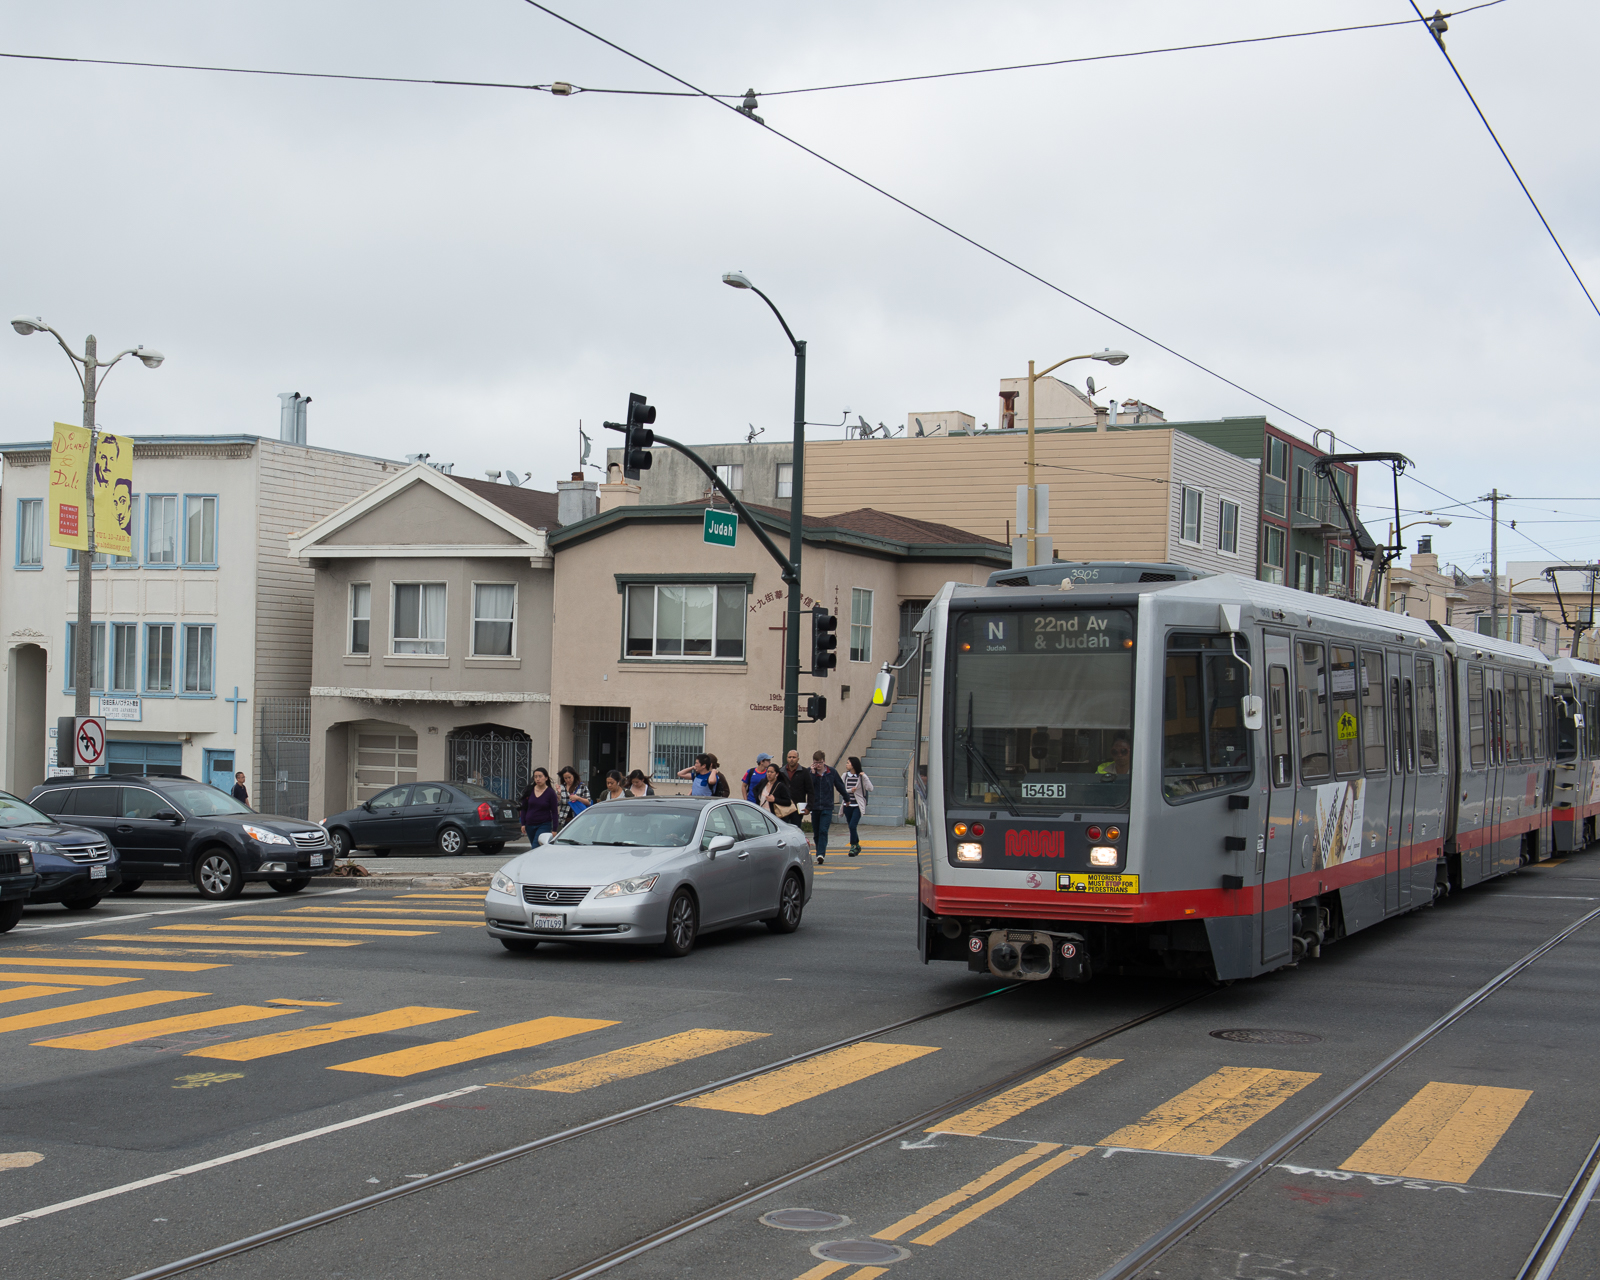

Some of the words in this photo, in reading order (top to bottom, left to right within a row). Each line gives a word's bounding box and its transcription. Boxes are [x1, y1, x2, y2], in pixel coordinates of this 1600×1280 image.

[708, 520, 733, 537] Judah
[96, 531, 107, 539] JUL
[988, 622, 1004, 640] N
[1034, 616, 1079, 632] 22nd
[1086, 616, 1108, 631] Av
[1034, 635, 1047, 650] &
[1055, 632, 1110, 649] Judah
[769, 693, 783, 701] 19th
[749, 703, 772, 711] Chinese
